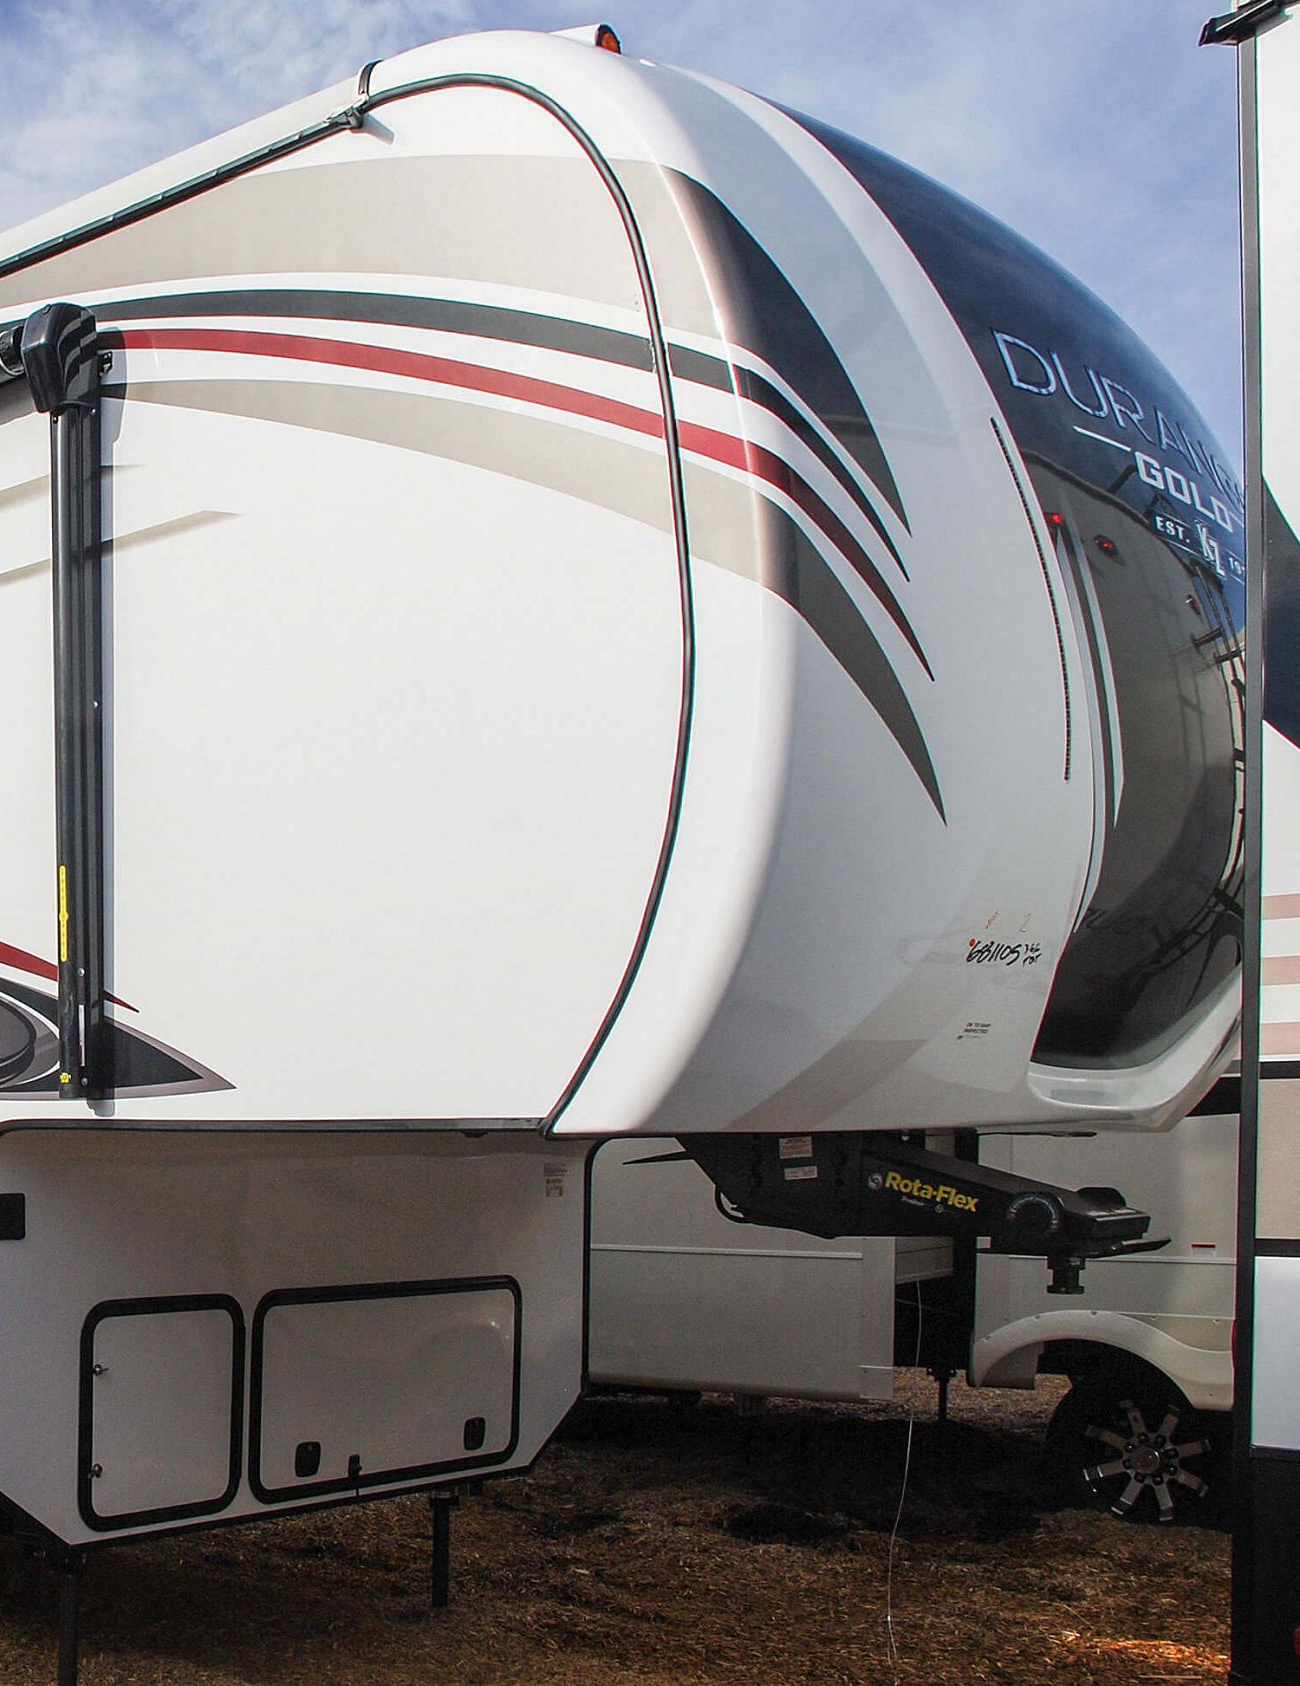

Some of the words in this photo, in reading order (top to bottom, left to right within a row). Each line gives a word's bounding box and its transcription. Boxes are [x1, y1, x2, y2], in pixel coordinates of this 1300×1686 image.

[1134, 451, 1233, 533] GOLD
[1155, 516, 1190, 543] EST.
[1229, 557, 1245, 575] 19
